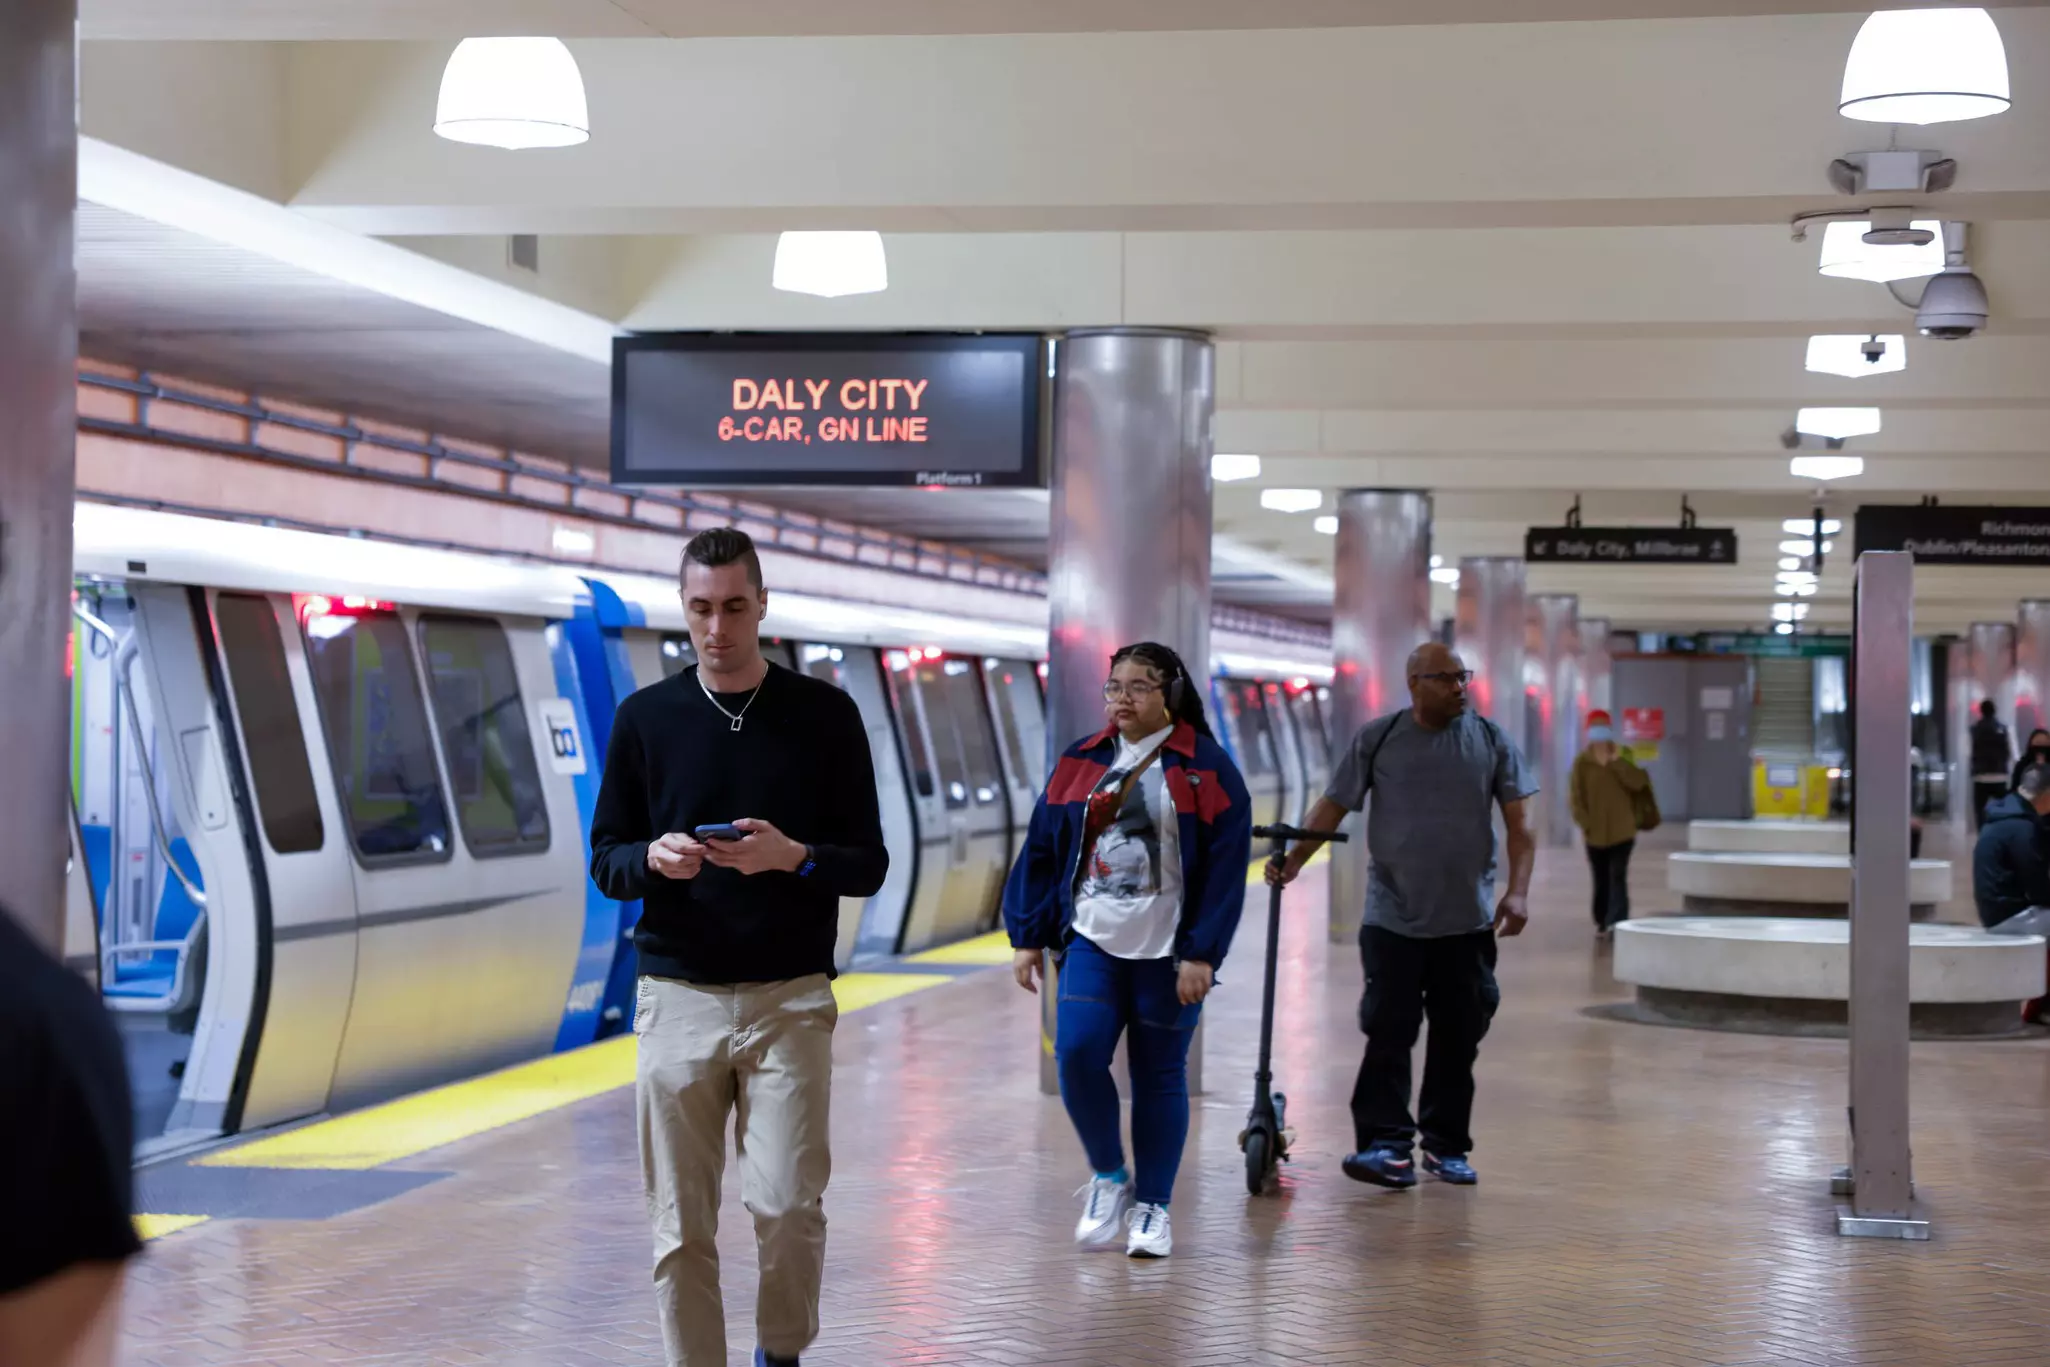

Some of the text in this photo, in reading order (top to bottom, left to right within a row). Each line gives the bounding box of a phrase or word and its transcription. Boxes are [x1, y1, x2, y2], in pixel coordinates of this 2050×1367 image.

[733, 378, 928, 410] DALY CITY
[718, 416, 928, 445] 6-CAR, GN LINE
[916, 471, 982, 485] Platform 1
[1981, 520, 2050, 536] Richmon
